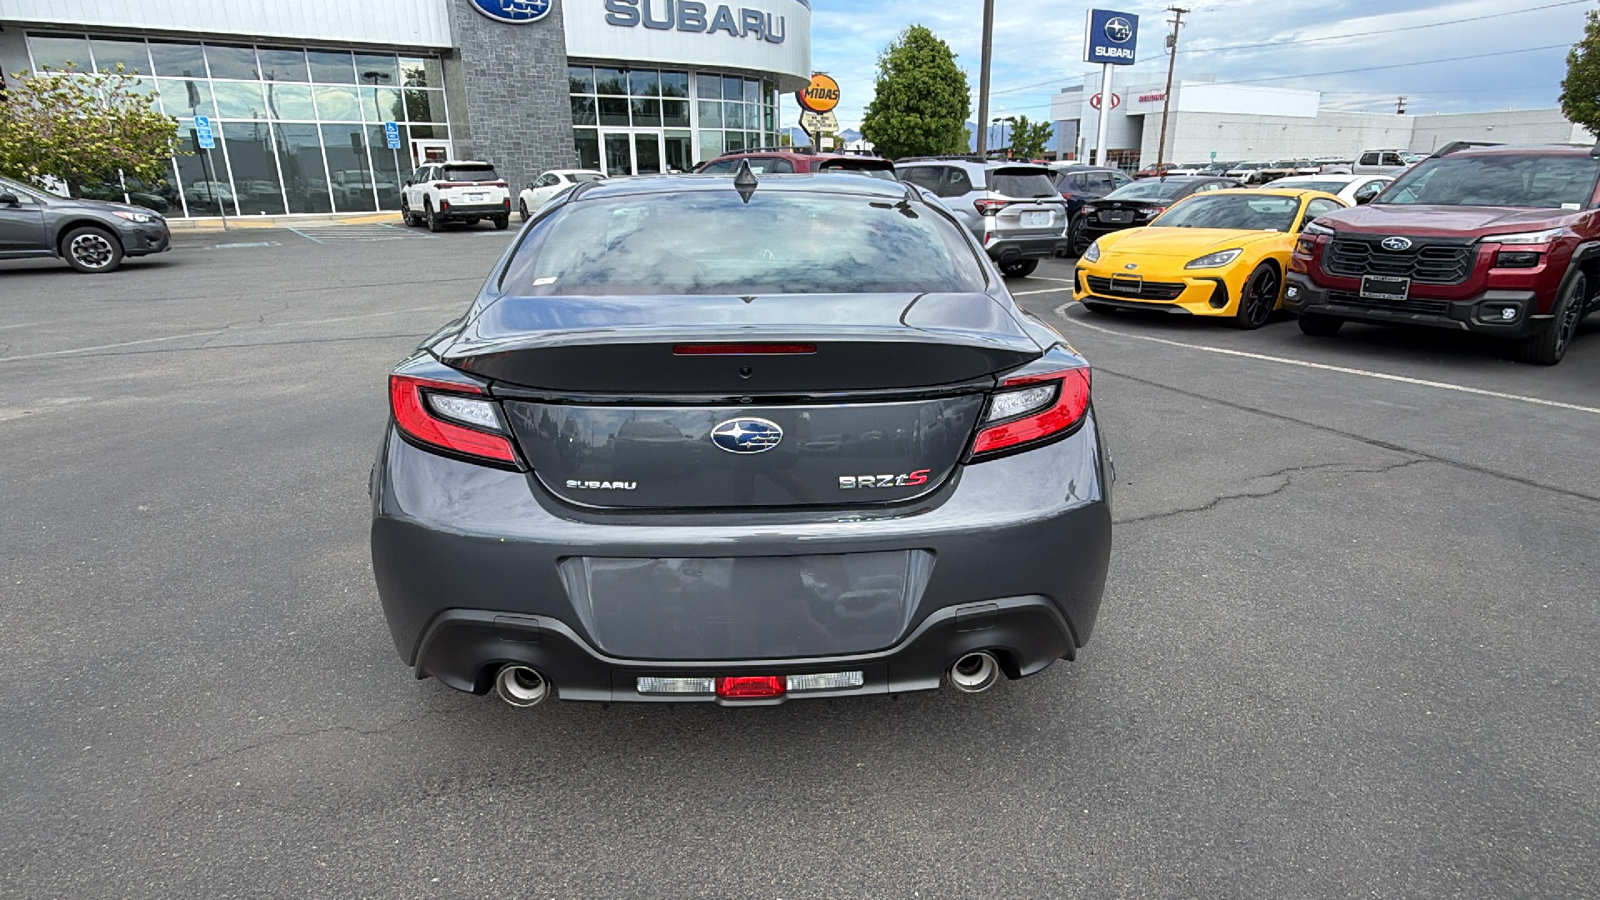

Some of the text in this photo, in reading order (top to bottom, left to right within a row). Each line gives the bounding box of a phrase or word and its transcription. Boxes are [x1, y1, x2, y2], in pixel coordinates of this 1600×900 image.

[604, 0, 786, 44] SUBARU
[1095, 46, 1134, 59] SUBARU
[804, 87, 839, 100] MIDAS
[565, 479, 638, 490] SUBARU
